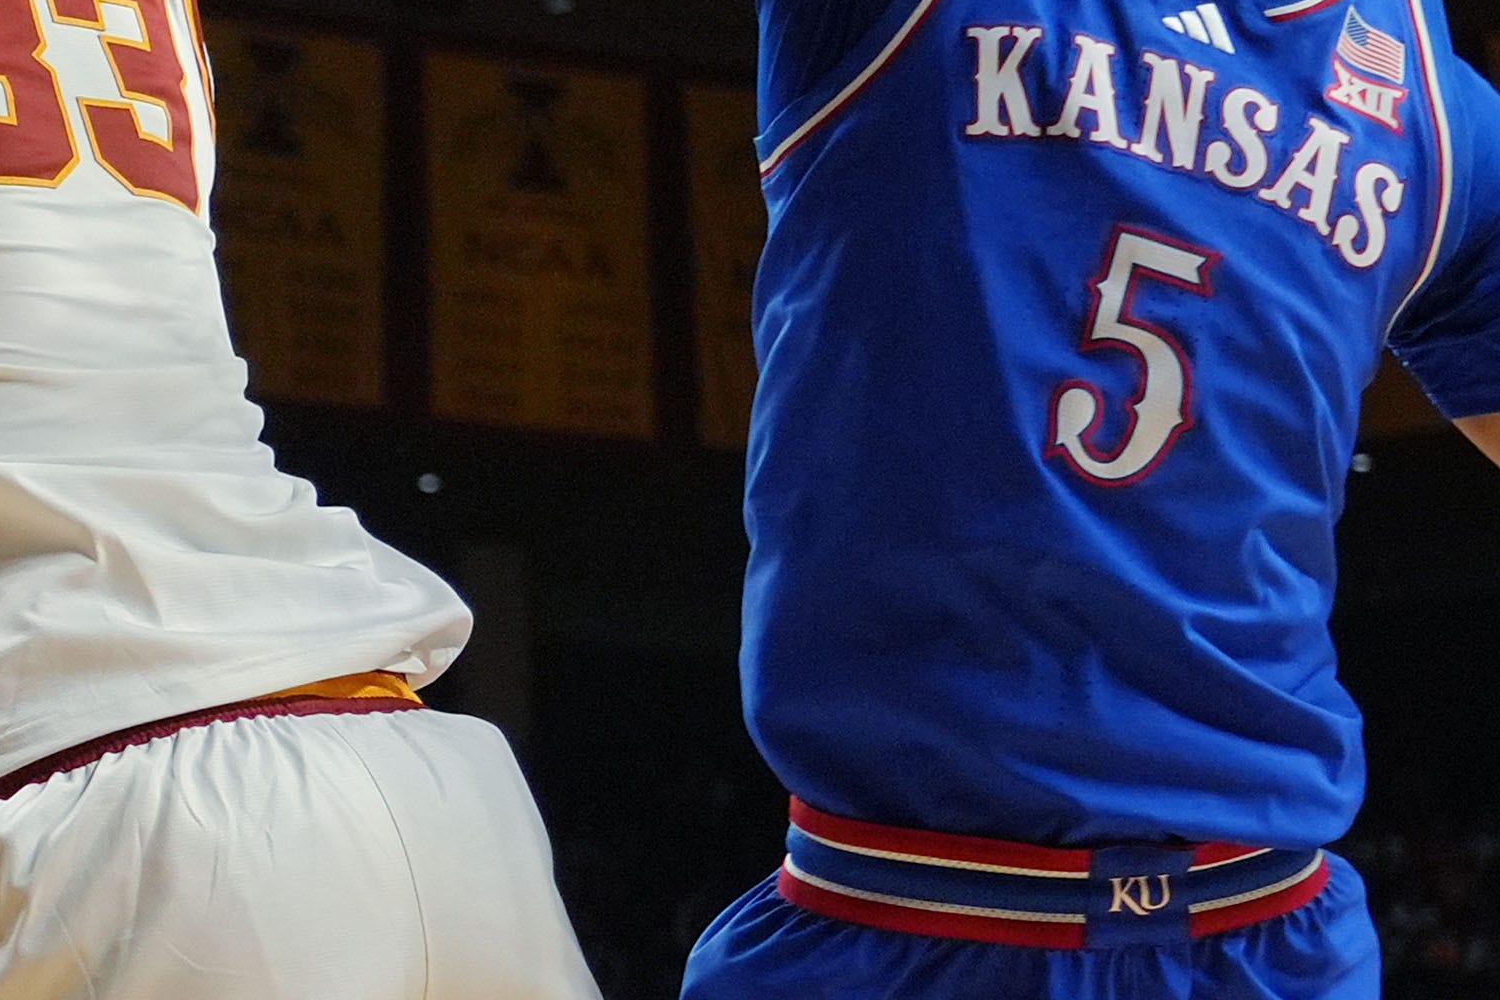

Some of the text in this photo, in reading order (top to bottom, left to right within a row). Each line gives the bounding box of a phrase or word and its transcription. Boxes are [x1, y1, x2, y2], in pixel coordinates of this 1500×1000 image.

[964, 24, 1406, 270] KANSAS
[1044, 225, 1221, 486] 5
[1107, 873, 1171, 916] KU
